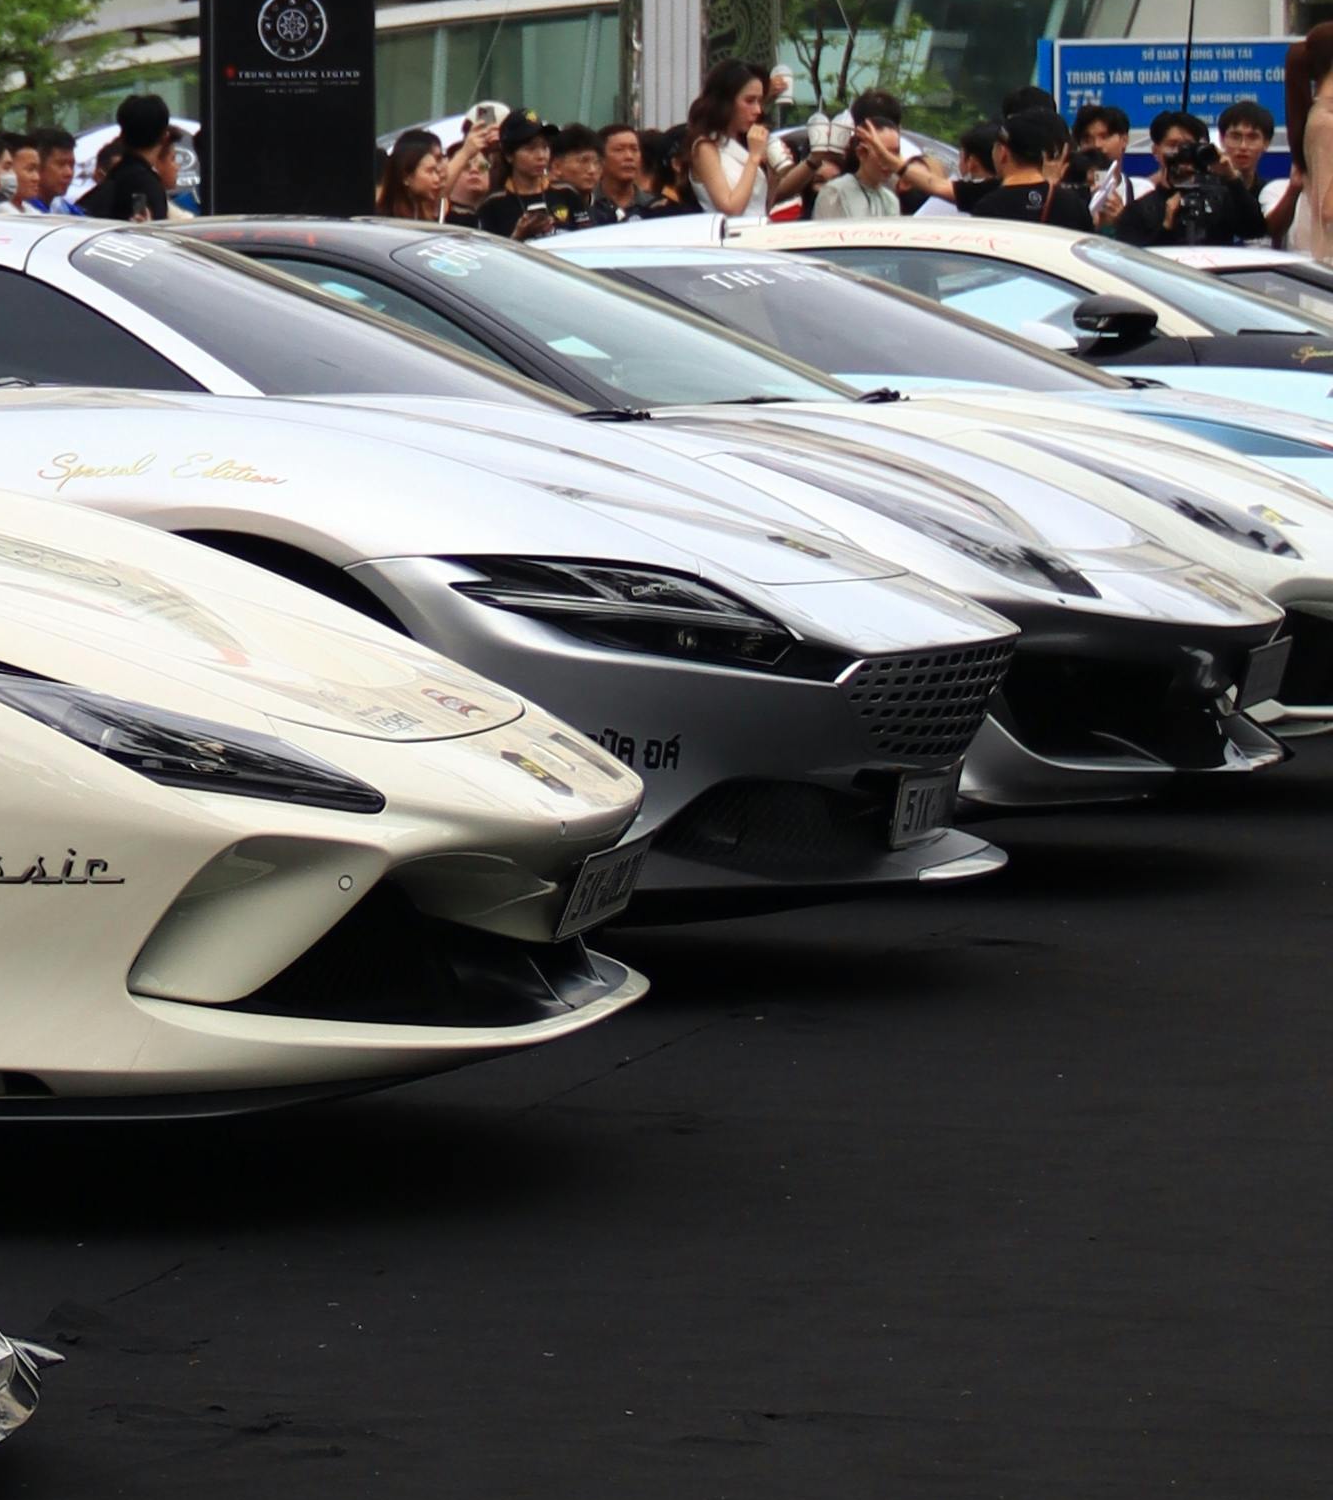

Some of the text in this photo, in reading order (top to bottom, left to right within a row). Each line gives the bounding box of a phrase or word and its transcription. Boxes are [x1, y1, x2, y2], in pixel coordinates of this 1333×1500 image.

[1066, 71, 1106, 84] TRUNG
[702, 268, 776, 290] THE
[38, 453, 288, 492] Special Edition
[643, 734, 683, 770] ĐÁ
